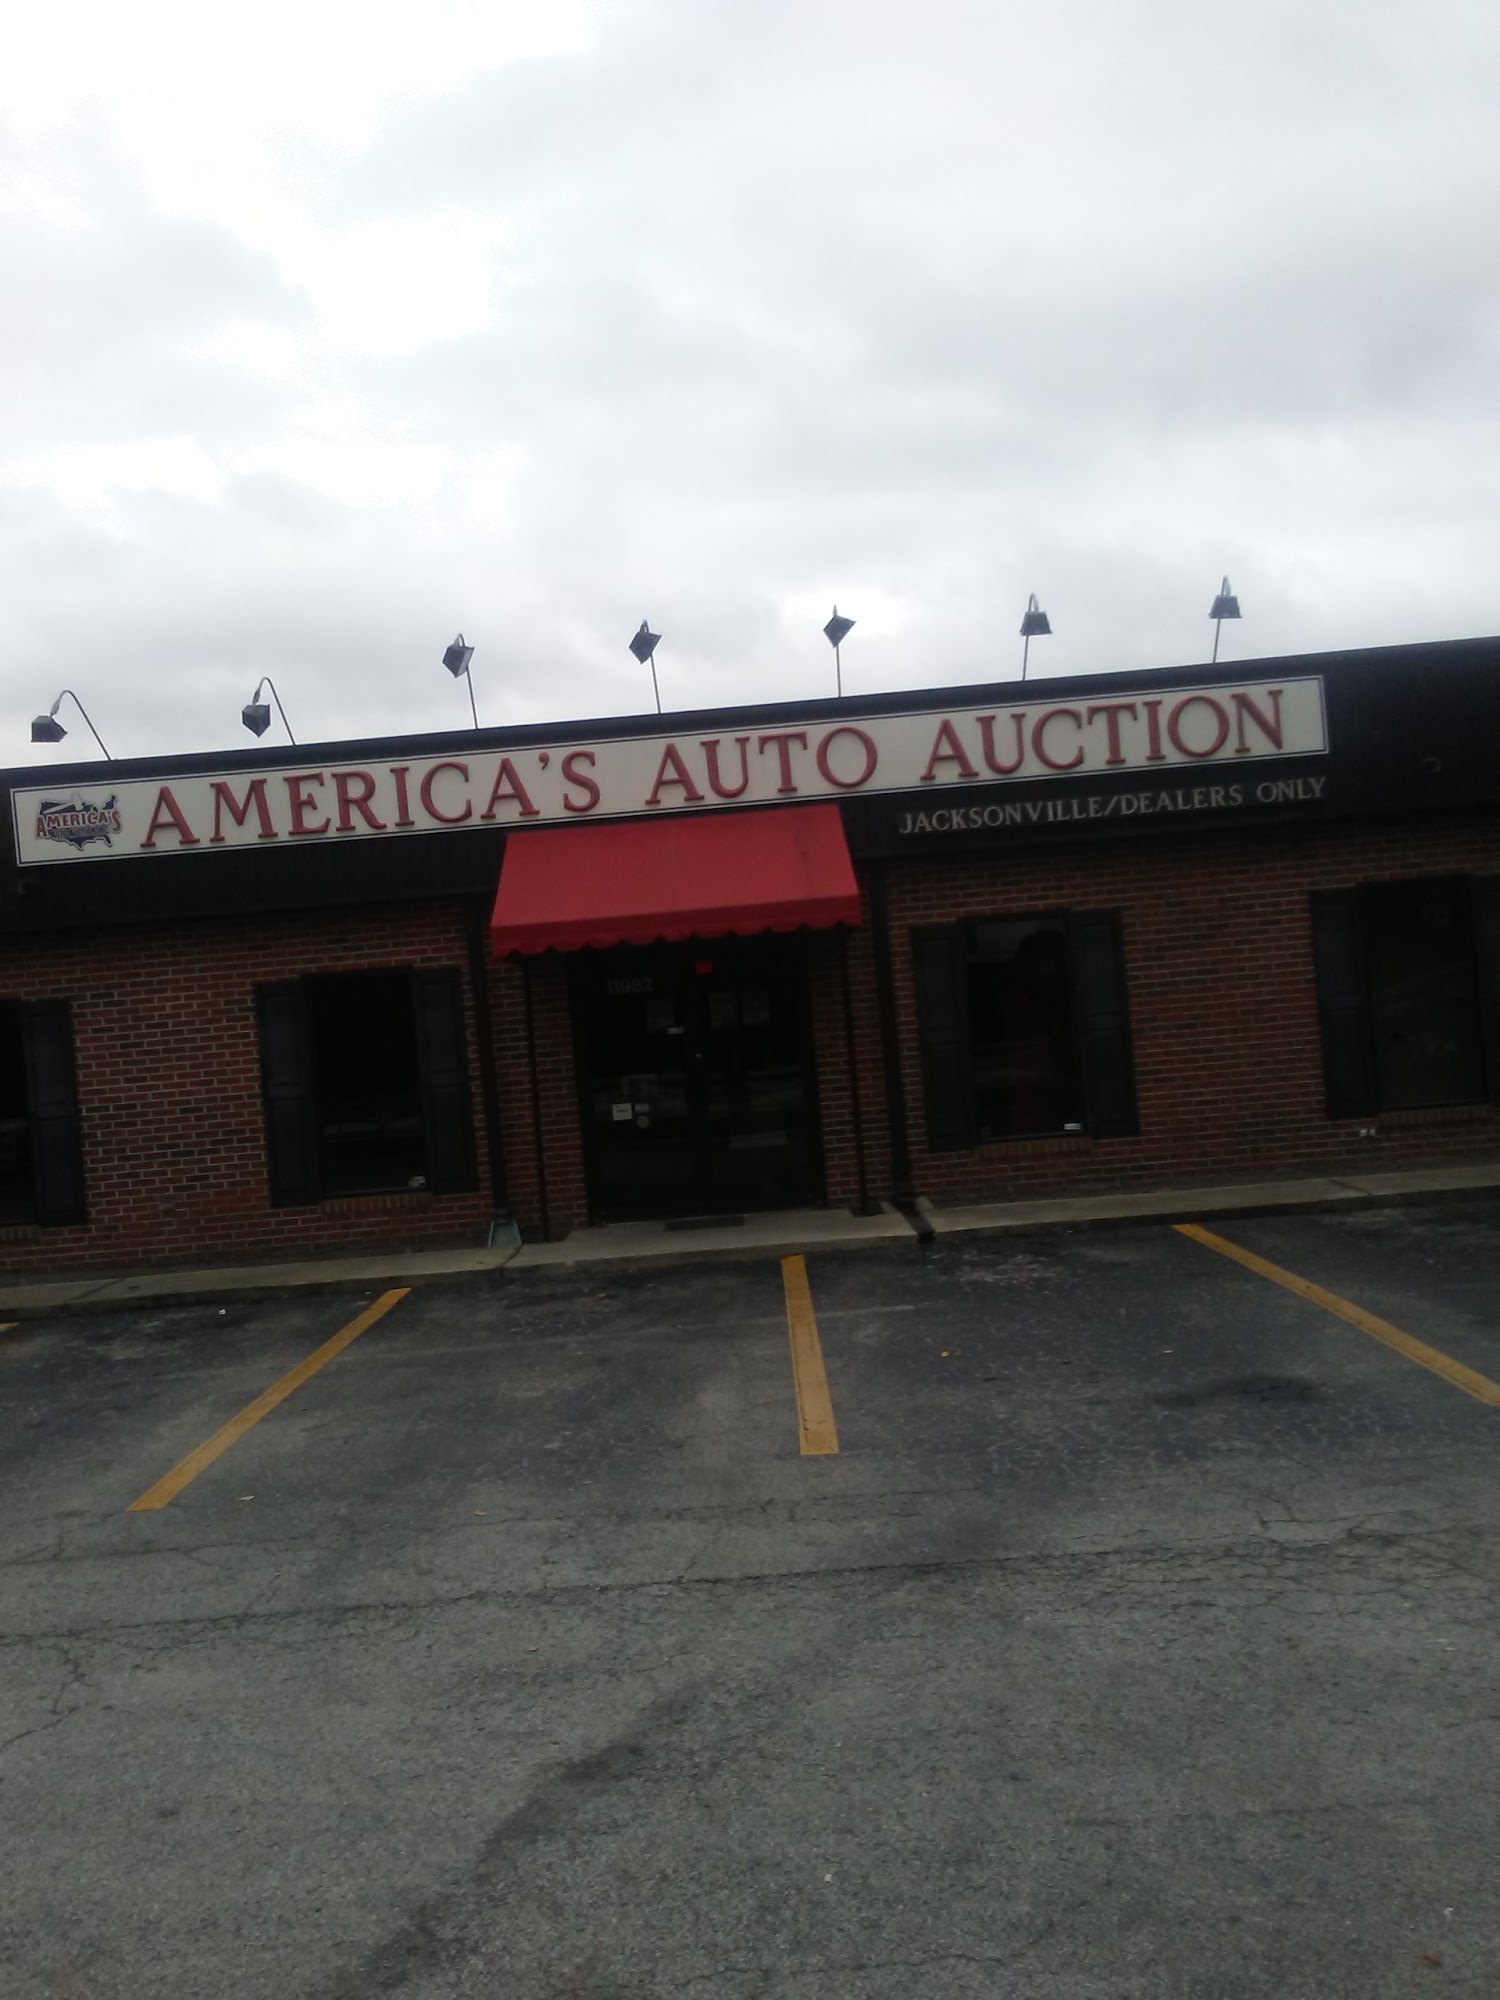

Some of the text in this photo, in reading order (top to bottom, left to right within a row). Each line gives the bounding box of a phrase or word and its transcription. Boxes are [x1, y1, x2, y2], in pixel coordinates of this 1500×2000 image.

[141, 690, 1282, 848] AMERICA'S AUTO AUCTION
[36, 810, 122, 838] AMERICA'S
[900, 777, 1326, 834] JACKSONVILLE/DEALERS ONLY
